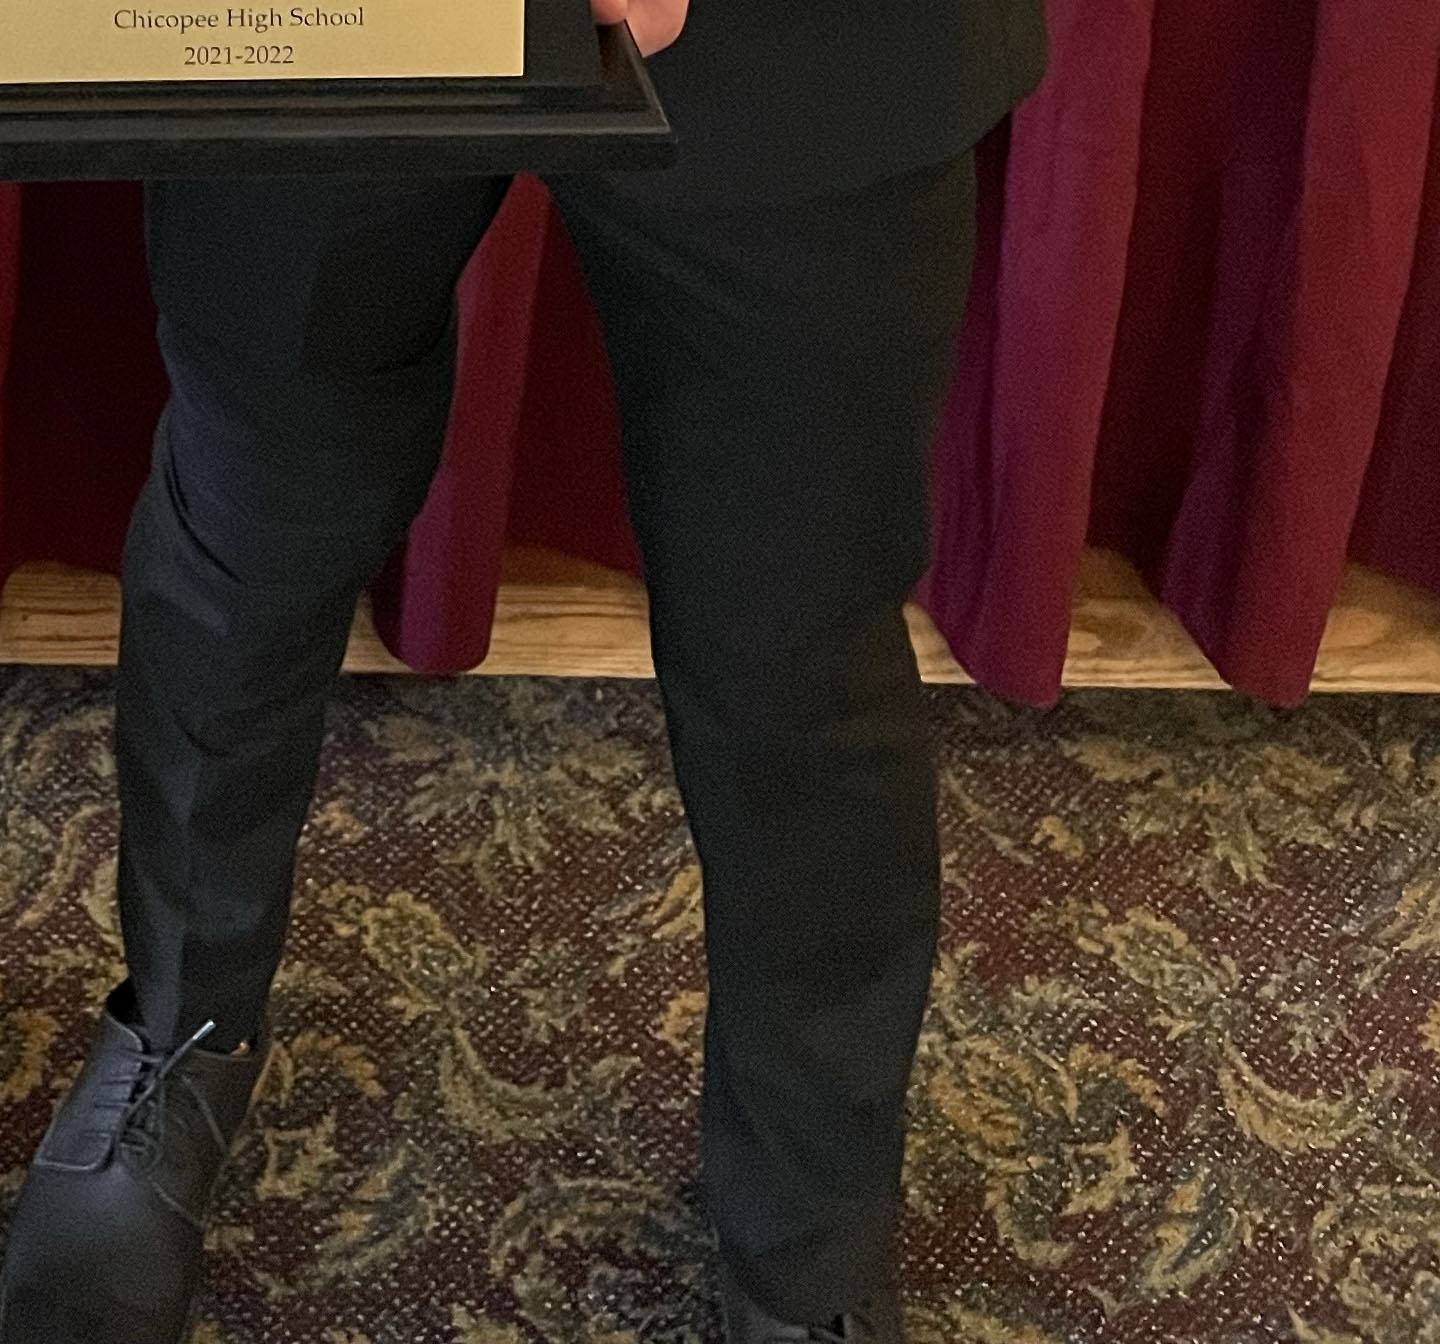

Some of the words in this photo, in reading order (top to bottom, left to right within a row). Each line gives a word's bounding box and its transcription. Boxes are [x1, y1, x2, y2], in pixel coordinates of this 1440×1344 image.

[113, 8, 219, 35] Chicopee
[226, 7, 283, 34] High
[289, 6, 365, 28] School
[183, 44, 295, 66] 2021-2022
